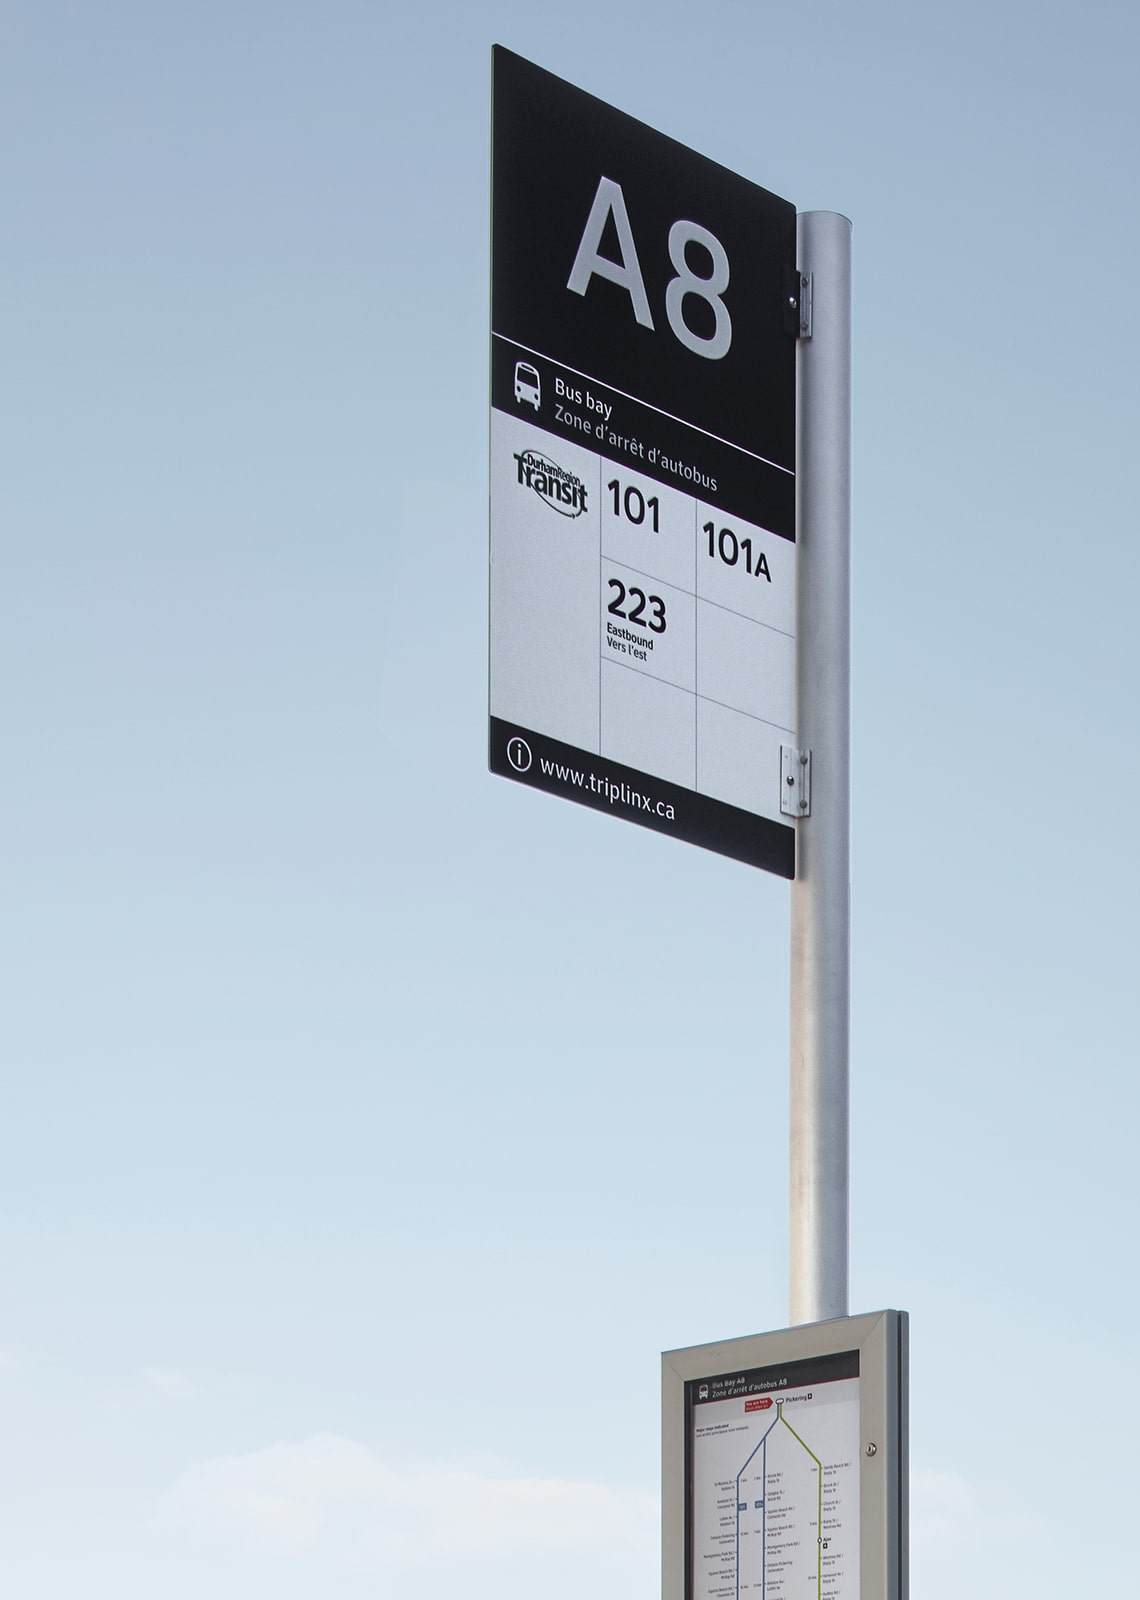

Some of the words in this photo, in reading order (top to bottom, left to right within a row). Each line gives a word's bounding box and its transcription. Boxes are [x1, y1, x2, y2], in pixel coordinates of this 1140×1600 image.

[566, 175, 732, 360] A8
[555, 377, 582, 405] Bus
[586, 391, 613, 421] bay
[554, 403, 592, 434] Zone
[595, 423, 644, 458] d'arrêt
[648, 447, 718, 492] d'autobus
[513, 453, 588, 512] Transit
[607, 479, 660, 534] 101
[702, 521, 772, 583] 101A
[607, 578, 667, 633] 223
[606, 635, 627, 653] Vers
[628, 644, 647, 661] l'est
[607, 621, 654, 650] Eastbound
[540, 757, 675, 821] www.triplinx.ca
[712, 1390, 726, 1398] Zone
[728, 1386, 748, 1396] d'arrêt
[748, 1381, 778, 1392] d'autobus
[778, 1378, 788, 1386] A8
